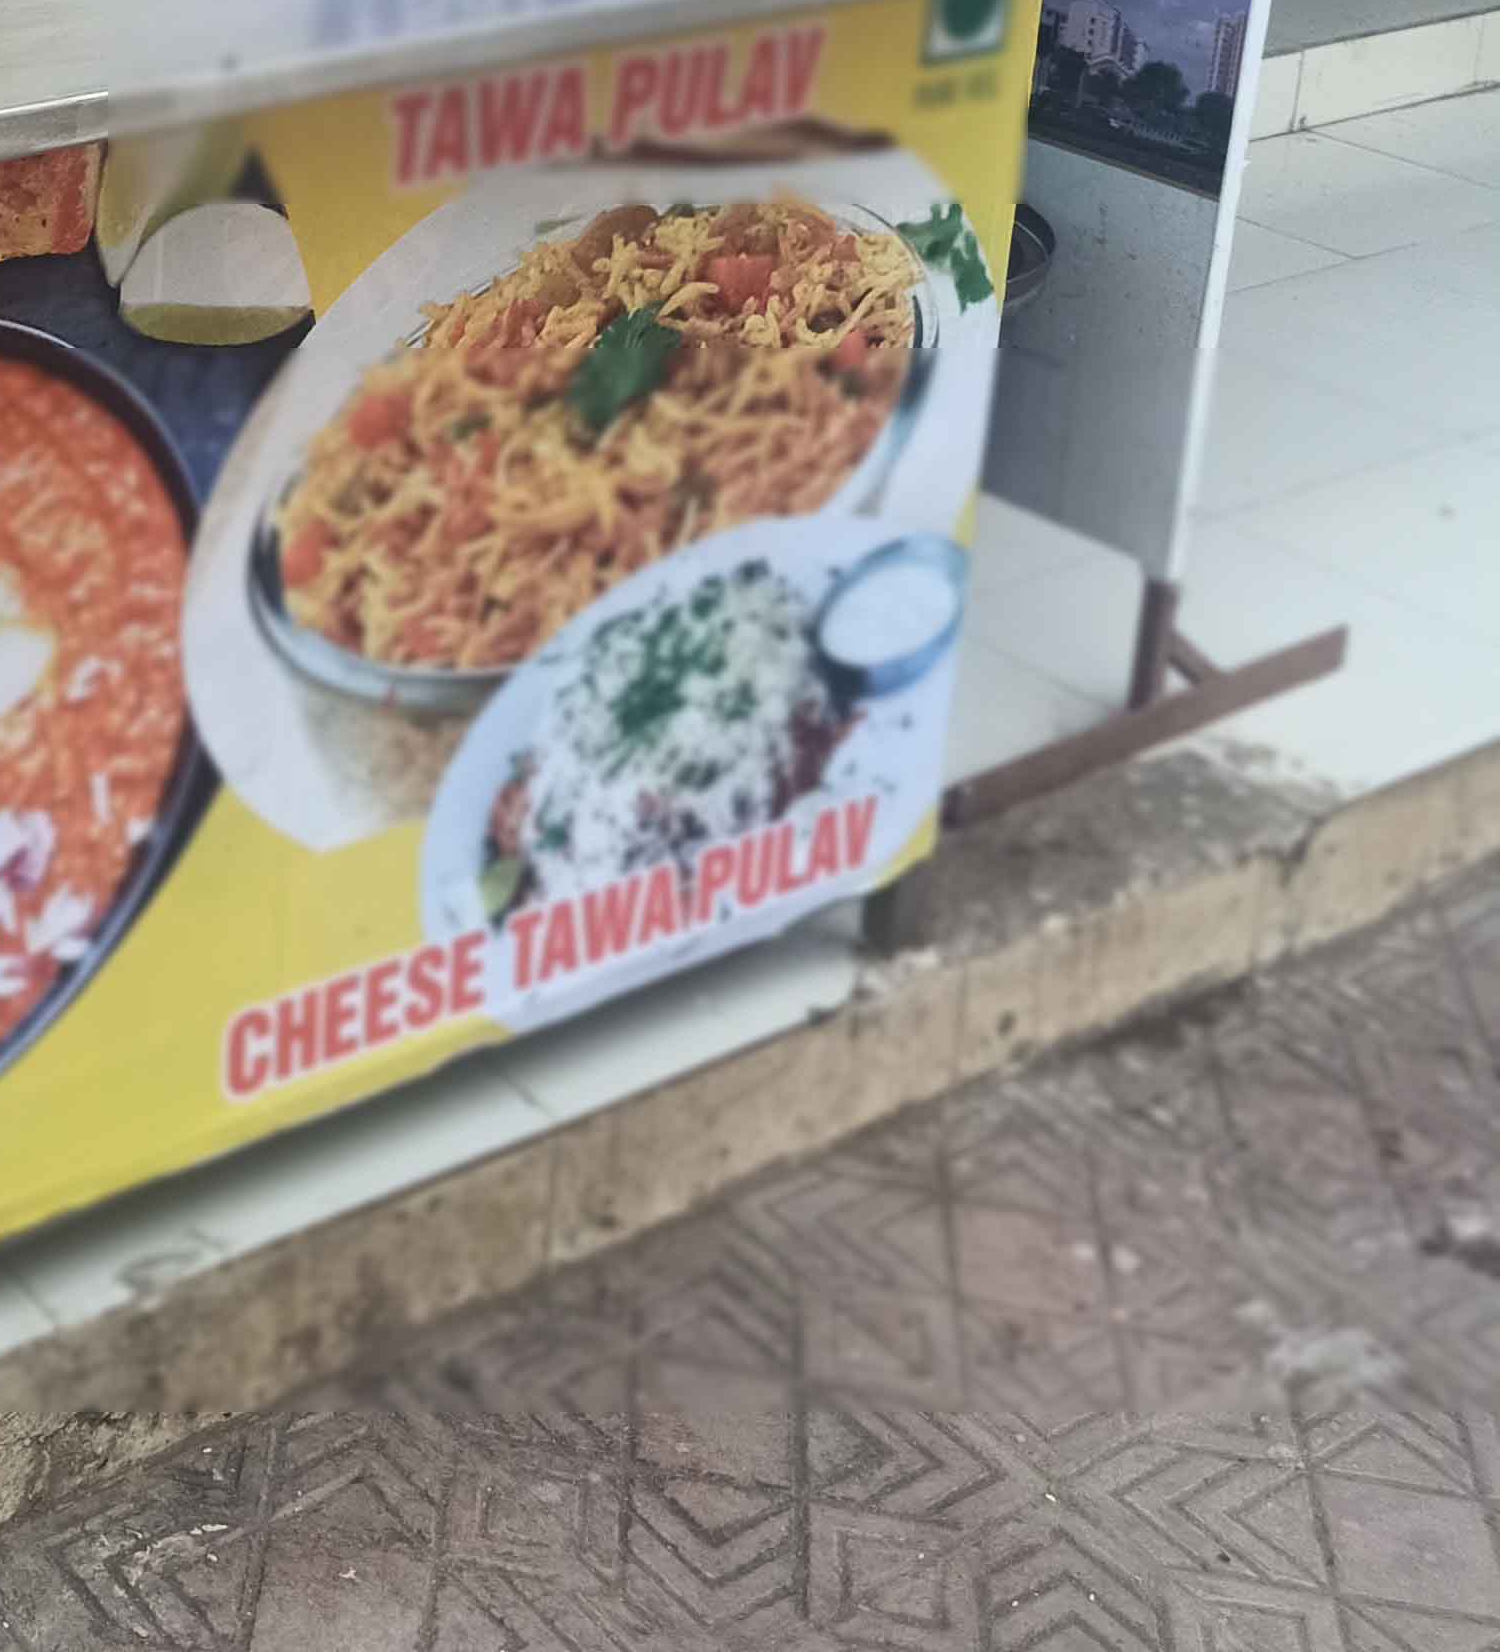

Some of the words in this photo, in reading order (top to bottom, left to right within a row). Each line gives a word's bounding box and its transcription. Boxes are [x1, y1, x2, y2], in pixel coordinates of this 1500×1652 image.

[390, 60, 586, 186] TAWA
[610, 36, 822, 140] PULAV
[227, 935, 487, 1096] CHEESE
[510, 863, 707, 990] TAWA
[700, 800, 878, 913] PULAV
